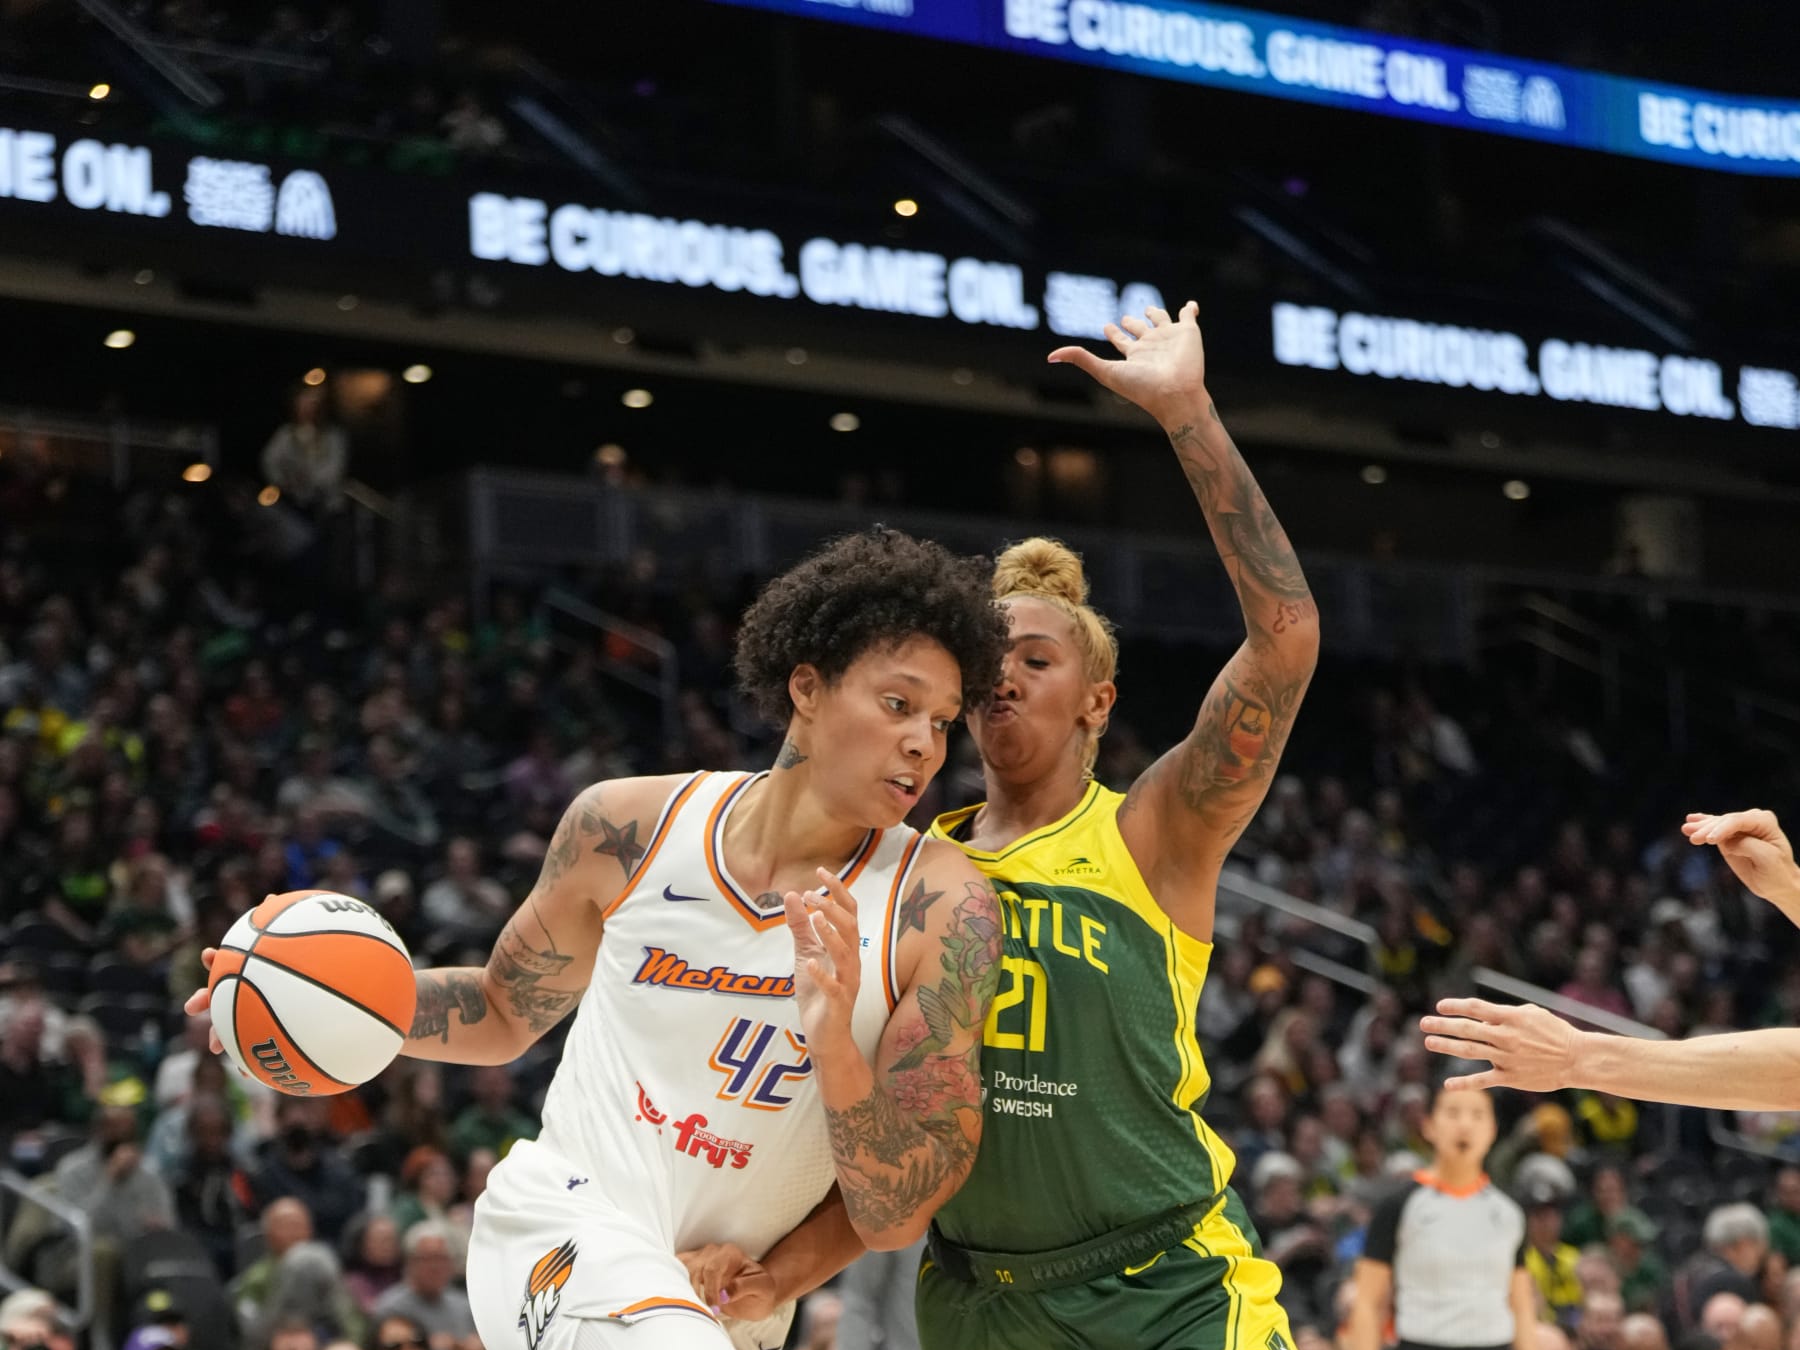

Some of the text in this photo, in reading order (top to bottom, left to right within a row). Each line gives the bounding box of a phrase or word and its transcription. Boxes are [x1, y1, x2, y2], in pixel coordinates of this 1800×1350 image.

[1004, 0, 1067, 43] BE
[1068, 1, 1266, 79] CURIOUS.
[1266, 30, 1388, 99] GAME
[1385, 50, 1460, 112] ON.
[1638, 92, 1694, 149] BE
[62, 138, 171, 217] ON.
[469, 192, 548, 266] BE
[550, 203, 799, 299] CURIOUS.
[799, 237, 949, 318] GAME
[949, 256, 1039, 331] ON.
[1272, 302, 1340, 370] BE
[1338, 312, 1541, 396] CURIOUS.
[1539, 339, 1662, 411] GAME
[1659, 354, 1736, 421] ON.
[1053, 867, 1102, 875] SYMETRA
[632, 945, 796, 998] Mercu
[996, 889, 1107, 975] TTLE
[983, 954, 1048, 1052] 21
[708, 1015, 813, 1112] 42
[672, 1113, 753, 1170] fry's
[694, 1129, 718, 1144] FOOD
